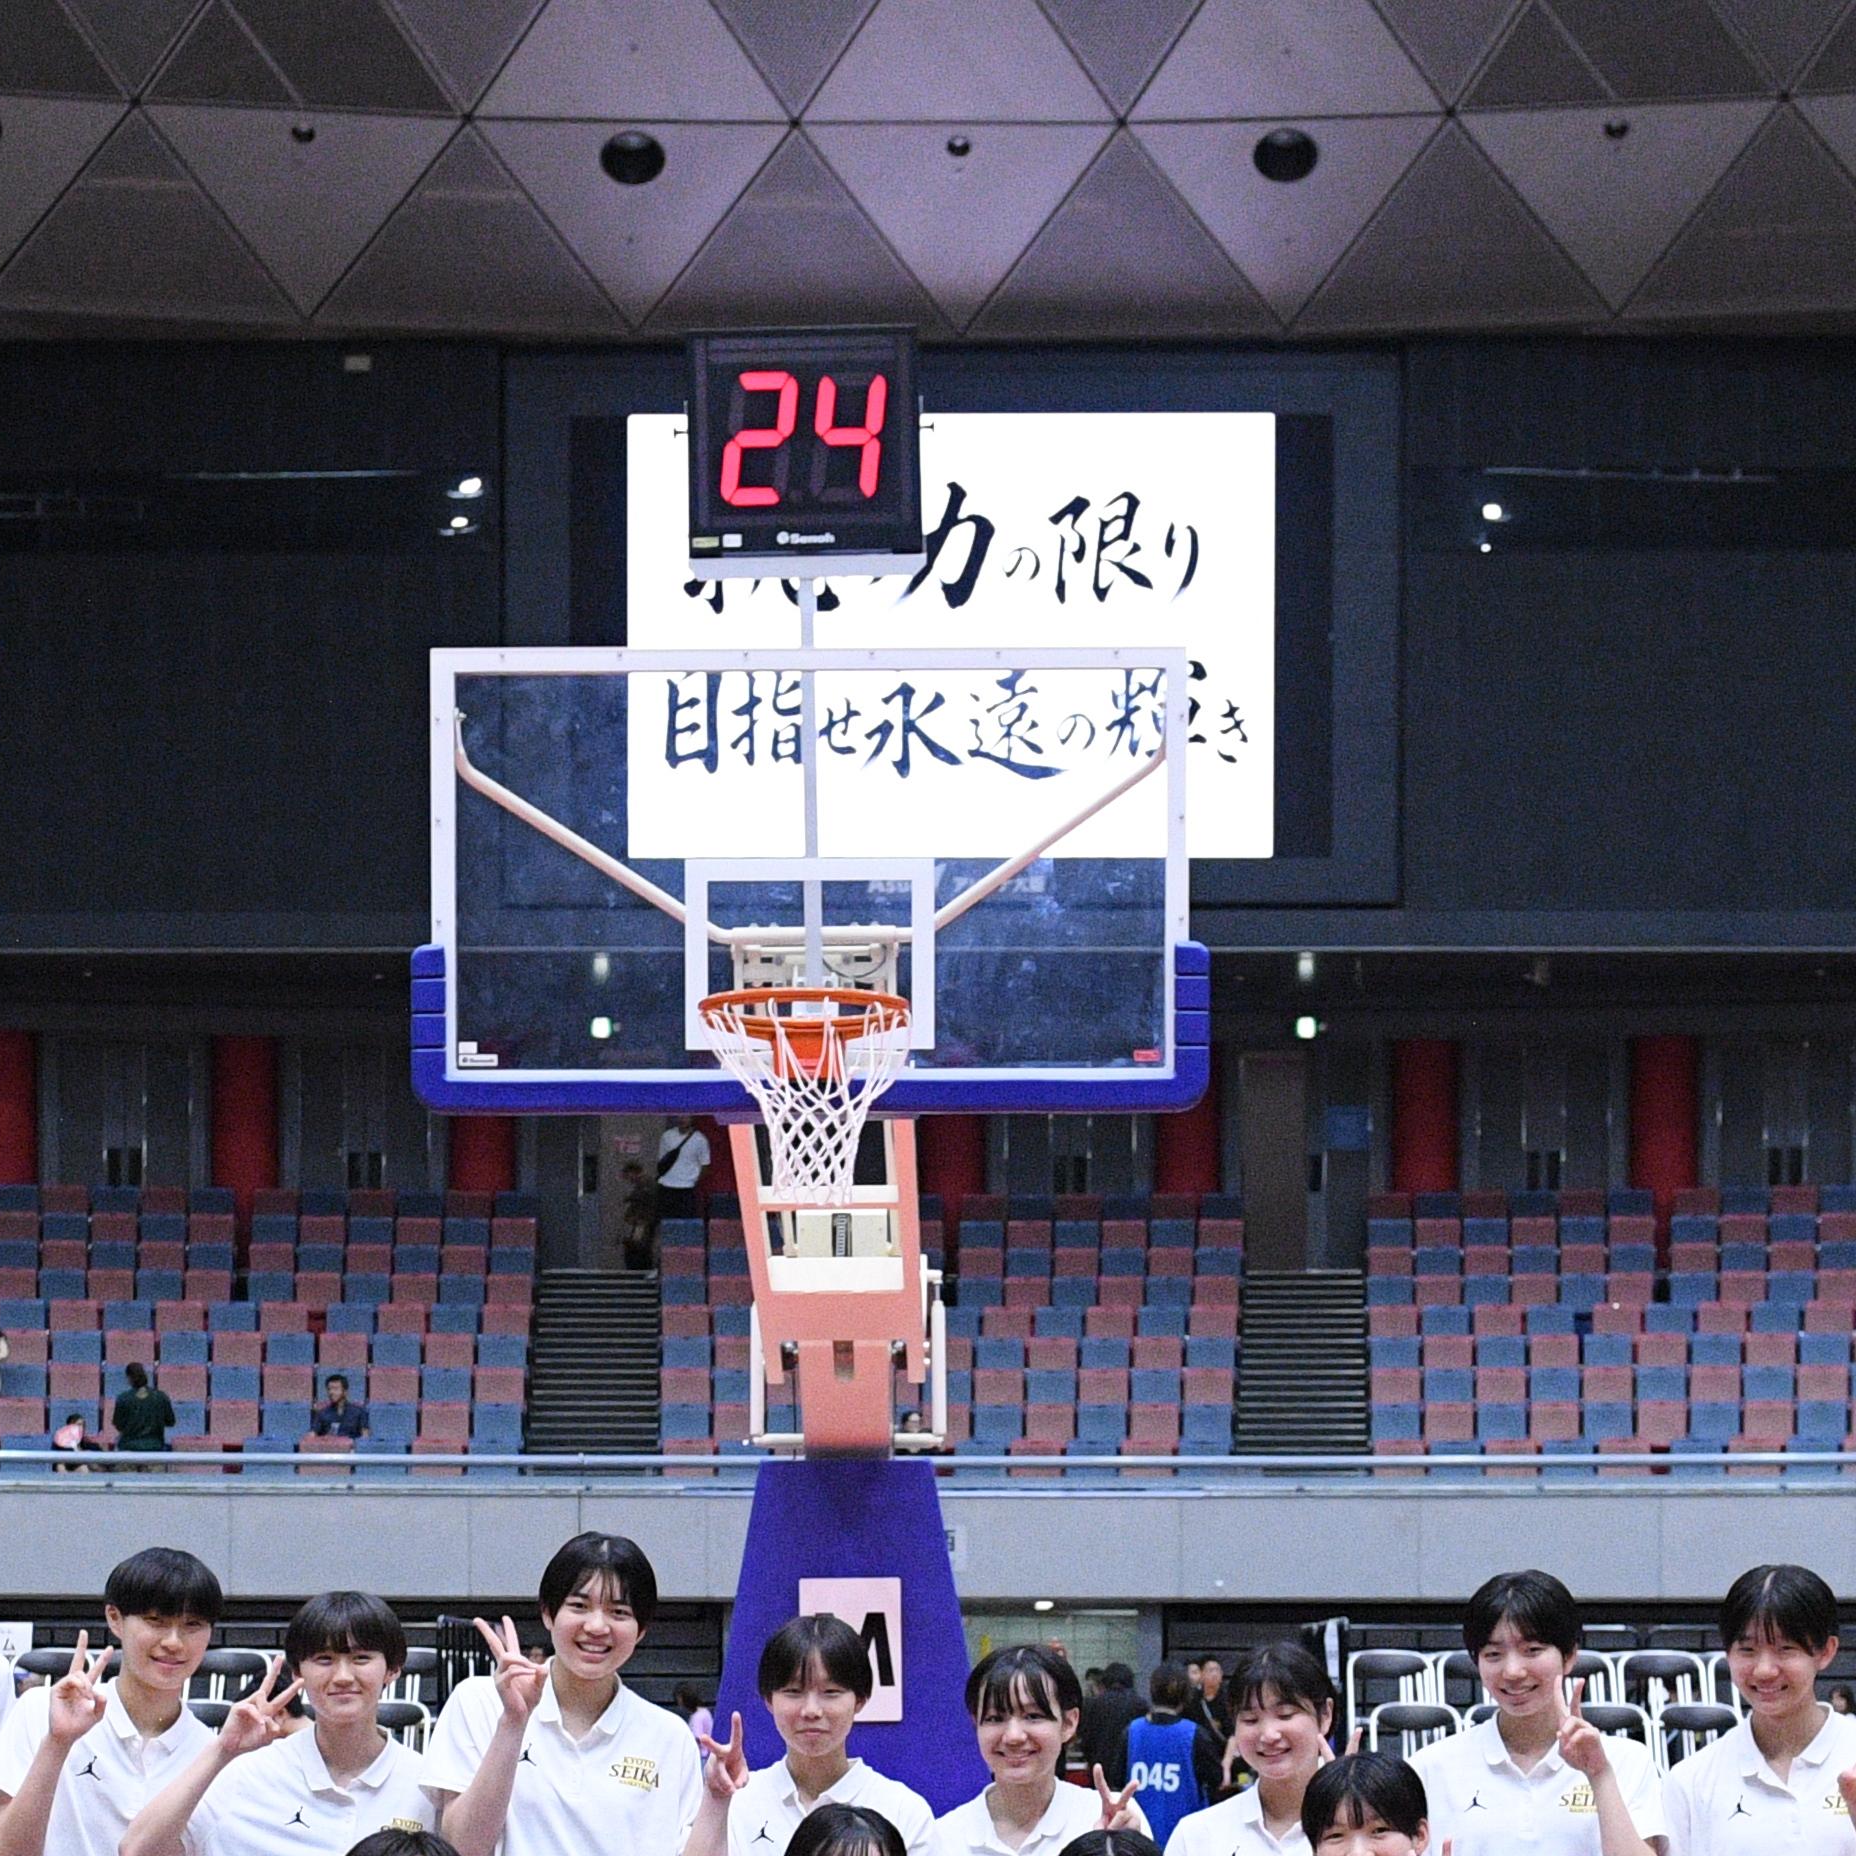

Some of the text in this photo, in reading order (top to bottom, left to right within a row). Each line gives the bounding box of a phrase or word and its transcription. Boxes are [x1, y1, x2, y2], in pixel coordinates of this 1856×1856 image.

[720, 371, 888, 506] 24
[609, 1764, 660, 1788] SEIKA
[1130, 1761, 1181, 1792] 045
[1559, 1792, 1596, 1807] SEI
